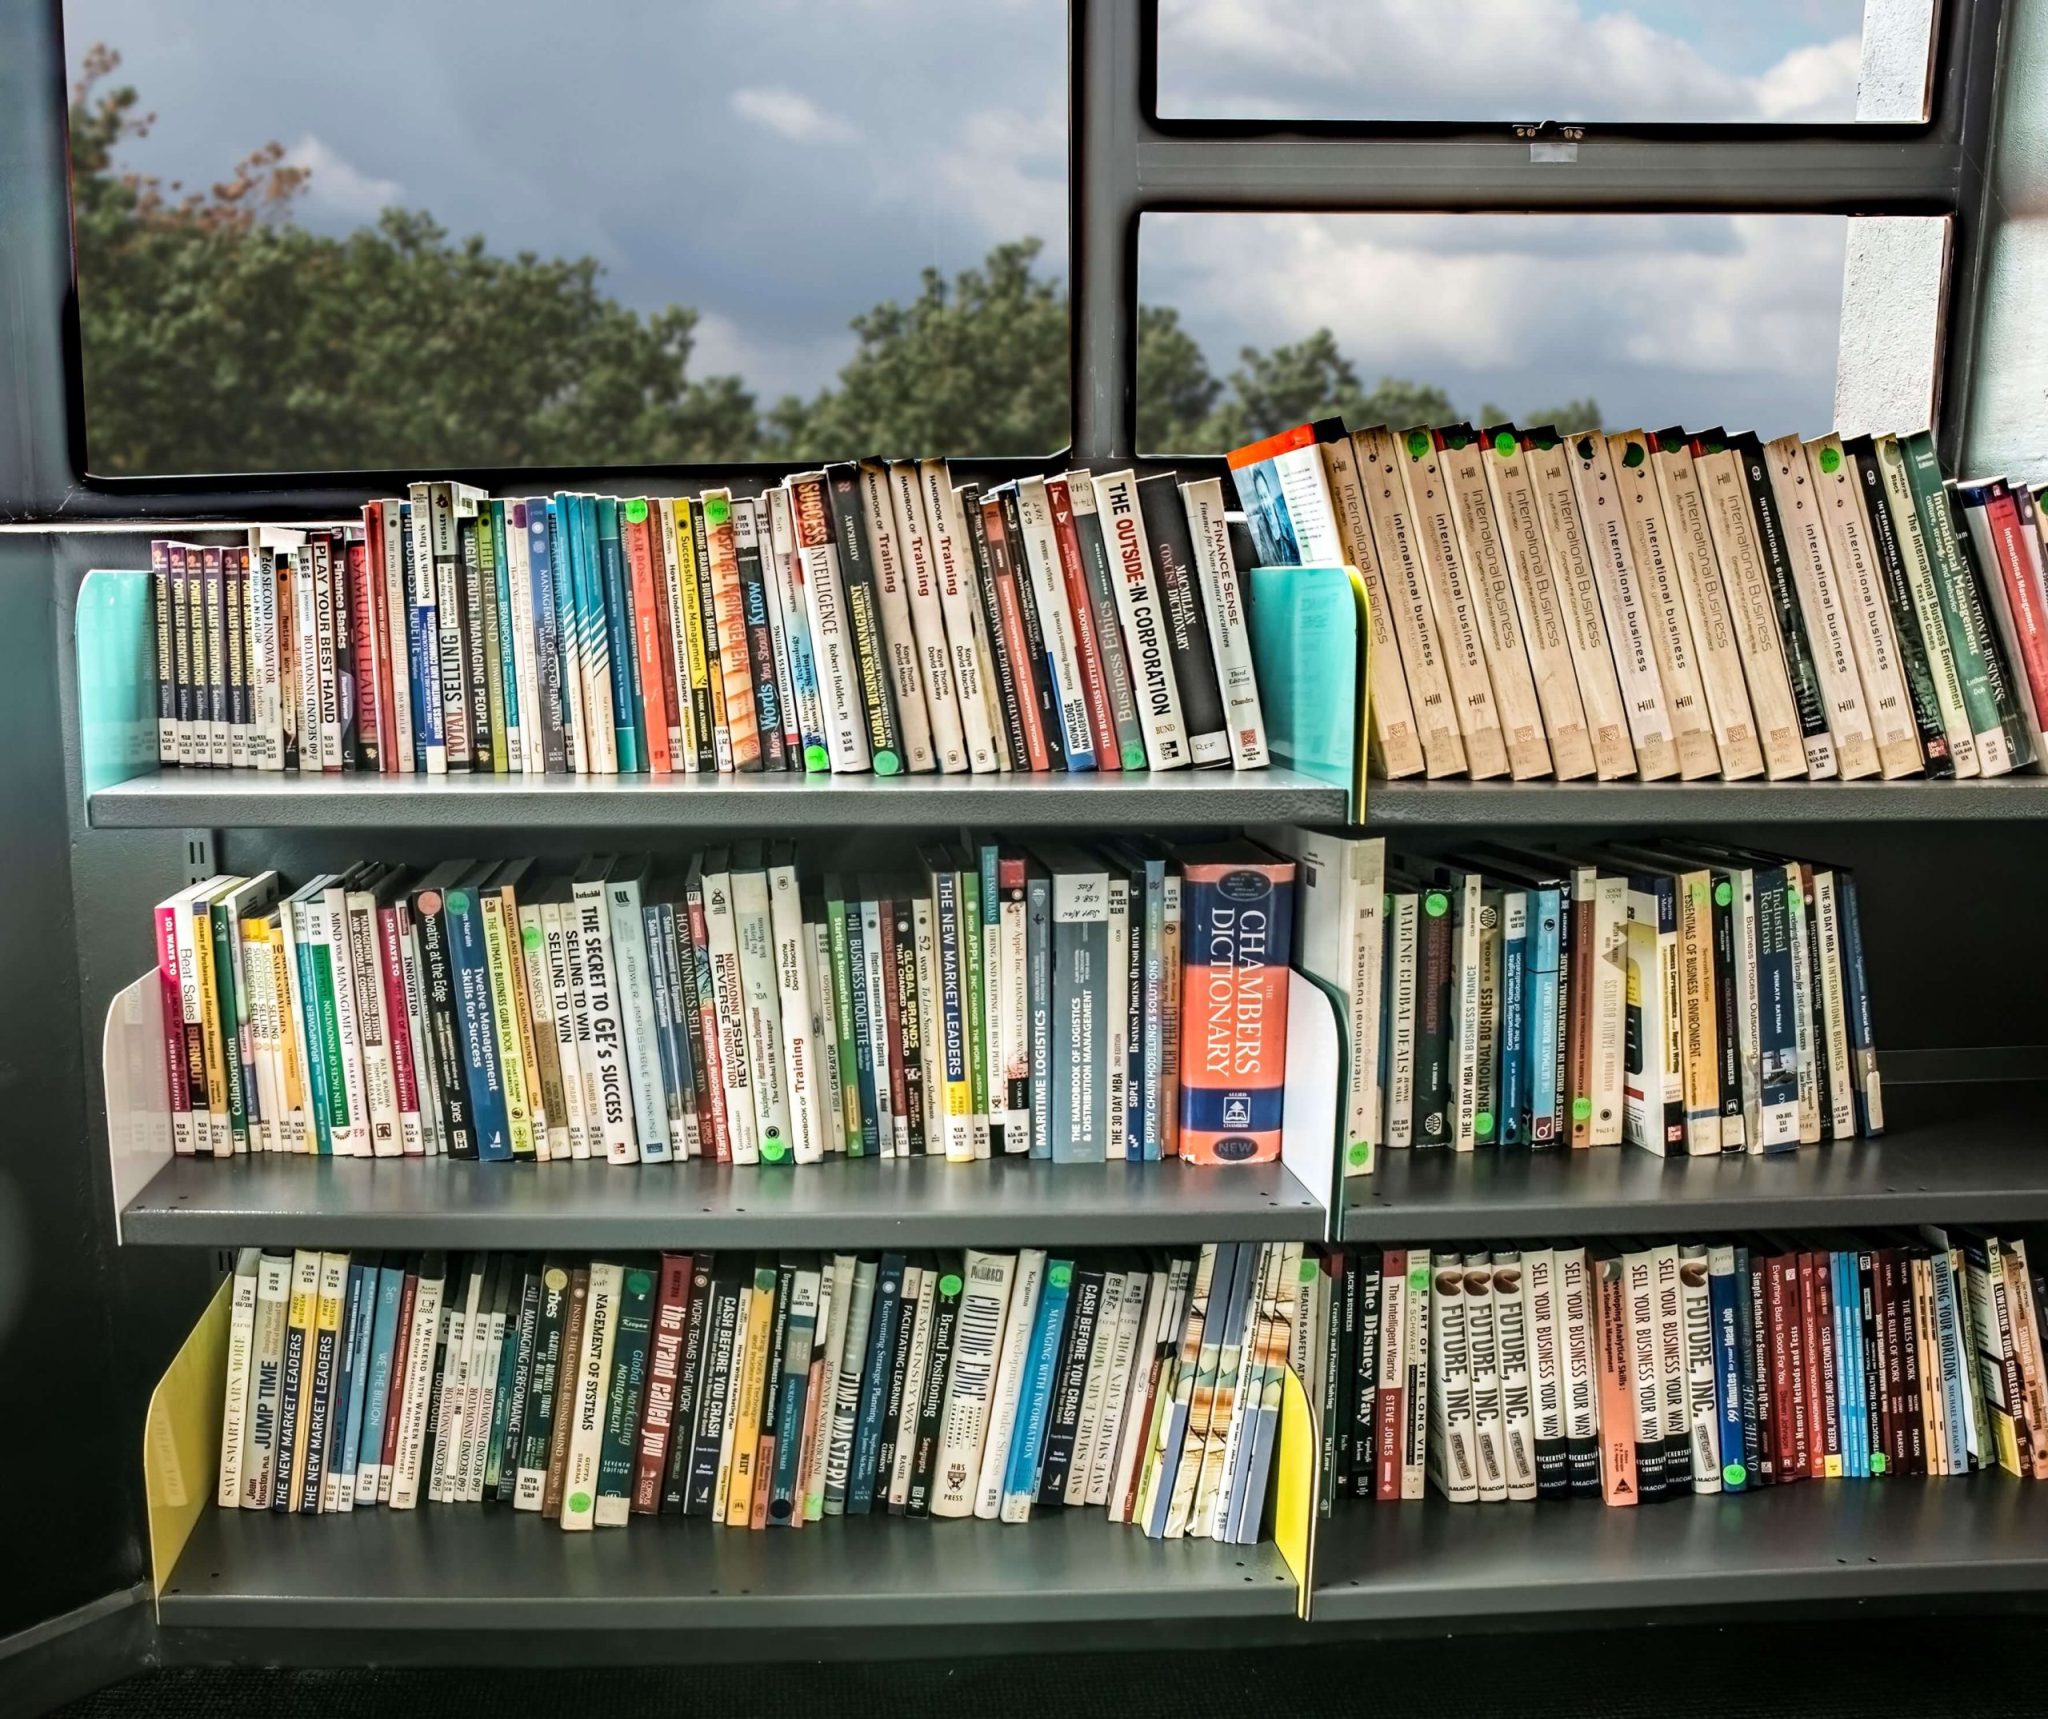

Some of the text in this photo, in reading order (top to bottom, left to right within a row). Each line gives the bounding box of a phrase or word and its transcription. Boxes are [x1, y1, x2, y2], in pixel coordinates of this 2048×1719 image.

[695, 516, 718, 651] BUILDING BRANDS BUILDING MEANING
[799, 482, 838, 636] SUCCESS INTELLIGENCE
[930, 475, 958, 596] HANDBOOK OF Training
[1199, 502, 1231, 648] Finance for Non-Finance Executives
[1212, 520, 1238, 627] FINANCE SENSE
[1435, 513, 1479, 666] international business
[1472, 489, 1517, 649] International Business
[1759, 497, 1791, 609] INTERNATIONAL BUSINESS
[1933, 491, 1979, 655] International Management
[156, 574, 169, 680] POWER SALES PRESENTATIONS
[316, 546, 335, 723] PLAY YOUR BEST HAND
[334, 560, 347, 649] Finance Basics
[464, 538, 488, 734] UGLY TRUTH MANAGING PEOPLE
[500, 601, 511, 662] BRAINPOWER
[681, 536, 701, 671] Successful Time Management
[748, 582, 767, 625] Know
[1108, 482, 1171, 716] THE OUTSIDE-IN CORPORATION
[1159, 543, 1189, 650] CONCISE DICTIONARY
[1174, 564, 1196, 625] MACMILLAN
[1907, 512, 1963, 710] The International Business Environment
[1914, 583, 1936, 650] Text and Cases
[441, 635, 467, 757] TOTAL SELLING
[760, 684, 778, 730] Words
[829, 643, 840, 673] Robert
[850, 584, 886, 747] GLOBAL BUSINESS MANAGEMENT
[956, 646, 971, 699] David Mackey
[964, 648, 976, 694] Kaye Thorne
[1099, 600, 1133, 722] Business Ethics
[581, 906, 598, 935] THE
[585, 937, 603, 988] SECRET
[1761, 891, 1773, 954] Relations
[1773, 887, 1786, 953] Industrial
[180, 948, 202, 1085] Beat Sales BURNOUT
[461, 968, 482, 1067] Skills for Success
[474, 967, 498, 1091] Twelve Management
[548, 932, 572, 1043] SELLING TO WIN
[593, 992, 607, 1011] TO
[716, 954, 738, 1088] REVERSE INNOVATION
[941, 881, 961, 1076] THE NEW MARKET LEADERS
[1207, 907, 1235, 1077] DICTIONARY
[1235, 910, 1266, 1074] CHAMBERS
[1397, 904, 1413, 1074] MAKING GLOBAL DEALS
[1822, 885, 1844, 1071] THE 30 DAY MBA IN INTERNATIONAL BUSINESS
[228, 1038, 242, 1115] Collaboration
[603, 1065, 622, 1124] SUCCESS
[1035, 1010, 1046, 1146] MARITIME LOGISTICS
[1220, 1142, 1253, 1154] NEW
[420, 1328, 432, 1373] WEEKEND
[509, 1309, 534, 1432] MANAGING PERFORMANCE
[707, 1297, 736, 1437] CASH BEFORE YOU CRASH
[923, 1314, 953, 1418] Brand Positioning
[1357, 1271, 1379, 1426] The Disney Way
[1385, 1284, 1399, 1381] The Intelligent Warrior
[1565, 1261, 1590, 1437] SELL YOUR BUSINESS YOUR WAY
[1934, 1261, 1956, 1382] SURFING YOUR HORIZONS
[255, 1403, 272, 1449] JUMP
[259, 1361, 278, 1400] TIME
[370, 1352, 387, 1426] WE THE BILLION
[412, 1402, 423, 1439] WARREN
[418, 1376, 426, 1398] WITH
[641, 1305, 685, 1457] the brand called you
[1384, 1395, 1394, 1456] STEVE JONES
[406, 1443, 418, 1481] BUFFETT
[1912, 1428, 1920, 1456] PEARSON
